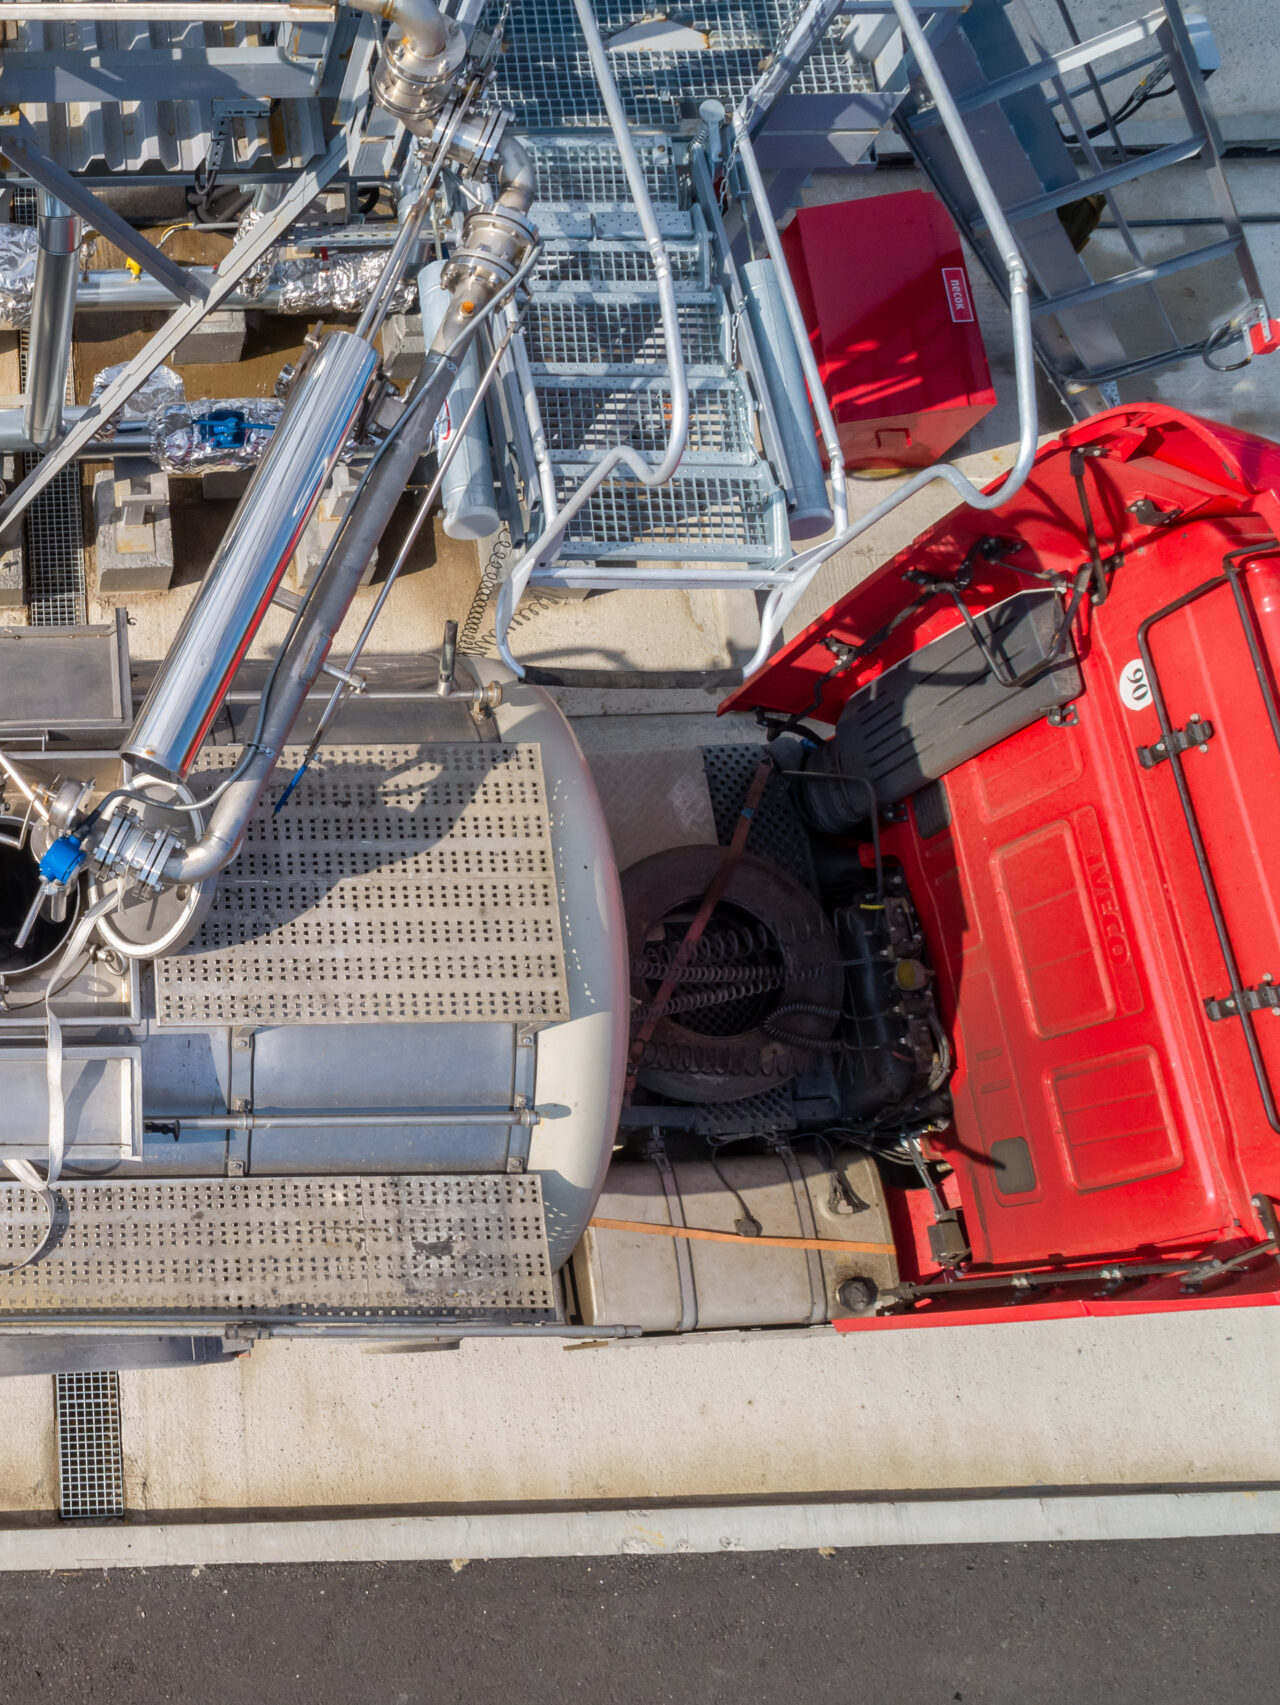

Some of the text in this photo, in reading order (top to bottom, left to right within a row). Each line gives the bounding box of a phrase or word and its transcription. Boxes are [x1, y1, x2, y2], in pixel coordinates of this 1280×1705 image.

[950, 279, 965, 310] песок
[1126, 667, 1149, 701] 90
[1085, 852, 1130, 965] IVECO
